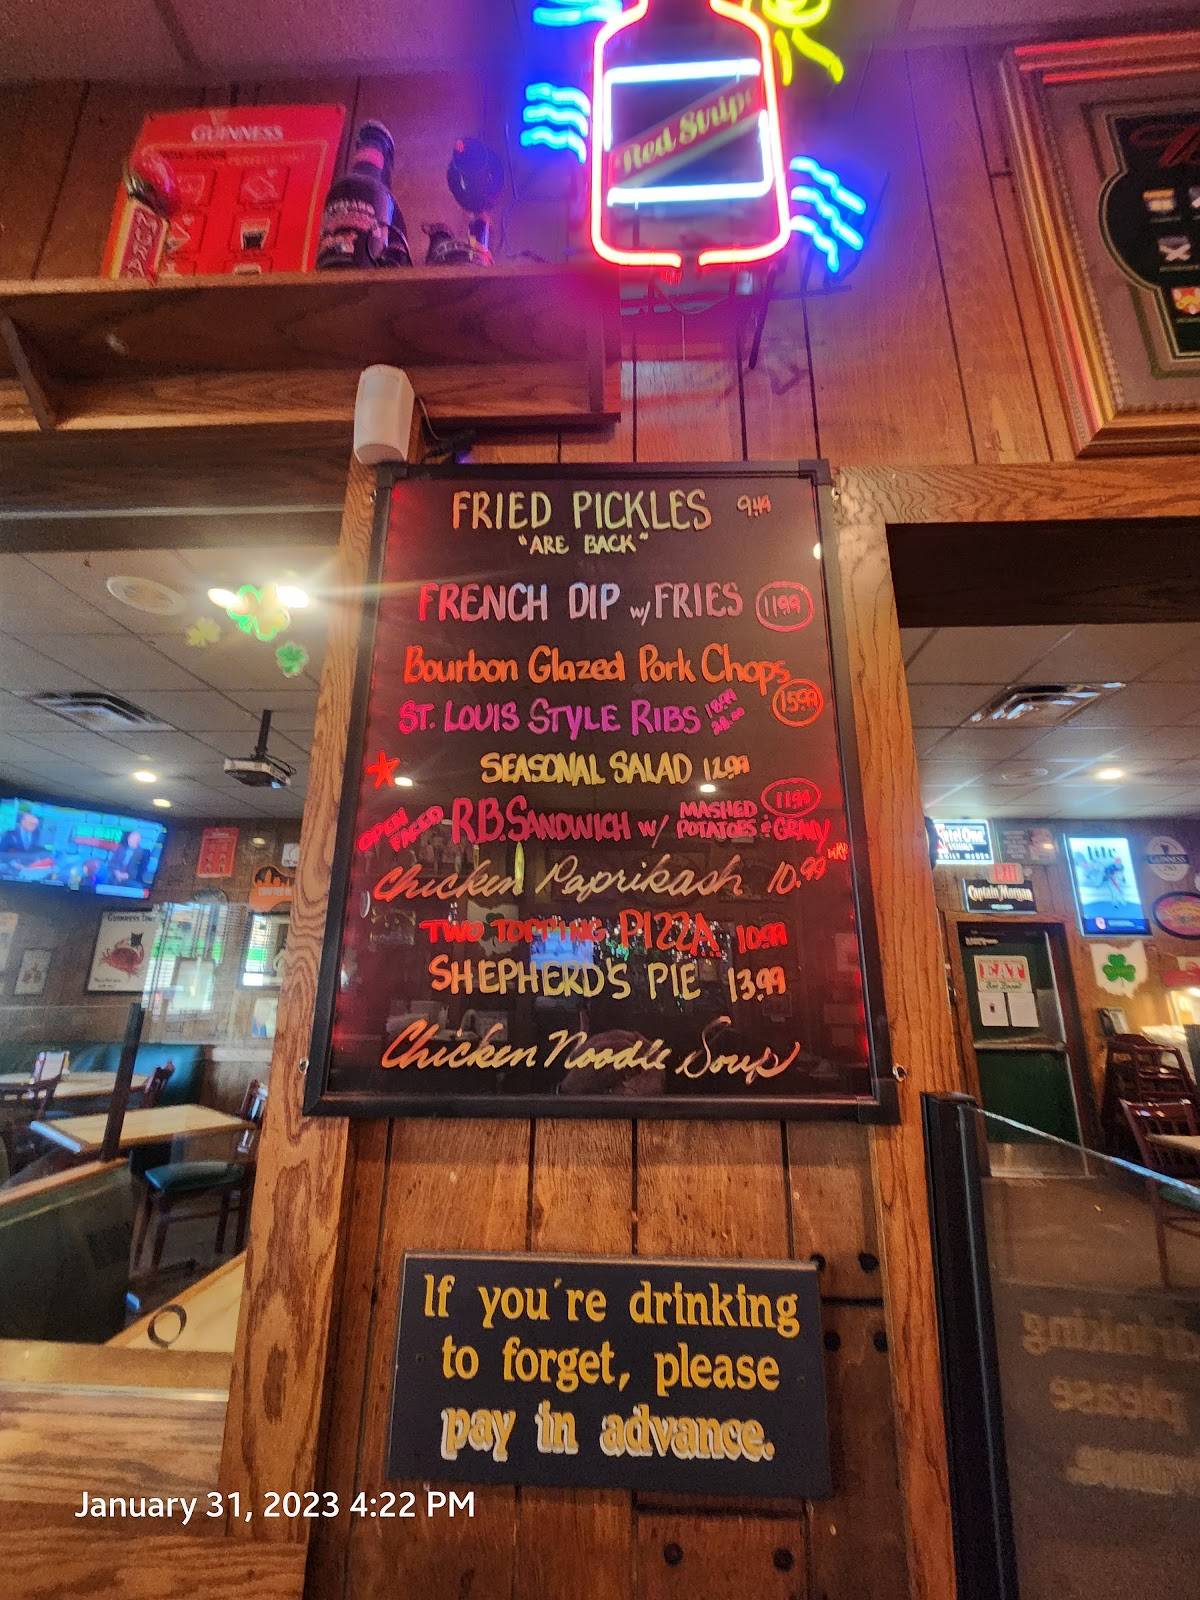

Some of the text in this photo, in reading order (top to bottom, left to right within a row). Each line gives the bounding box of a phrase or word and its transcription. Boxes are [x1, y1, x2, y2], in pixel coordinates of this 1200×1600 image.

[191, 123, 284, 143] GUINNESS
[452, 490, 552, 531] FRIED
[574, 489, 713, 531] PICKLES
[518, 531, 650, 556] "ARE BACK"
[418, 582, 549, 623] FRENCH
[569, 581, 621, 621] DIP
[403, 643, 791, 696] Bourbon Glazed Pork Chops
[399, 702, 436, 735] ST.
[444, 701, 518, 733] LOUIS
[631, 698, 701, 737] RIBS
[480, 751, 606, 787] SEASONAL
[609, 751, 693, 786] SALAD
[680, 800, 758, 819] MASHED
[372, 859, 524, 902] Chicken
[535, 853, 744, 903] Paprikash
[968, 885, 1001, 902] Captain
[994, 864, 1018, 883] EXIT
[418, 918, 485, 944] TWO
[488, 916, 607, 945] TOPPING
[618, 907, 722, 954] PIZZA
[427, 953, 632, 1000] SHEPHERD'S
[647, 961, 702, 1000] PIE
[381, 1018, 536, 1072] Chicken
[546, 1028, 669, 1072] Noodle
[423, 1273, 801, 1339] If you're drinking
[441, 1334, 780, 1398] to forget, please
[441, 1399, 776, 1463] pay in advance.
